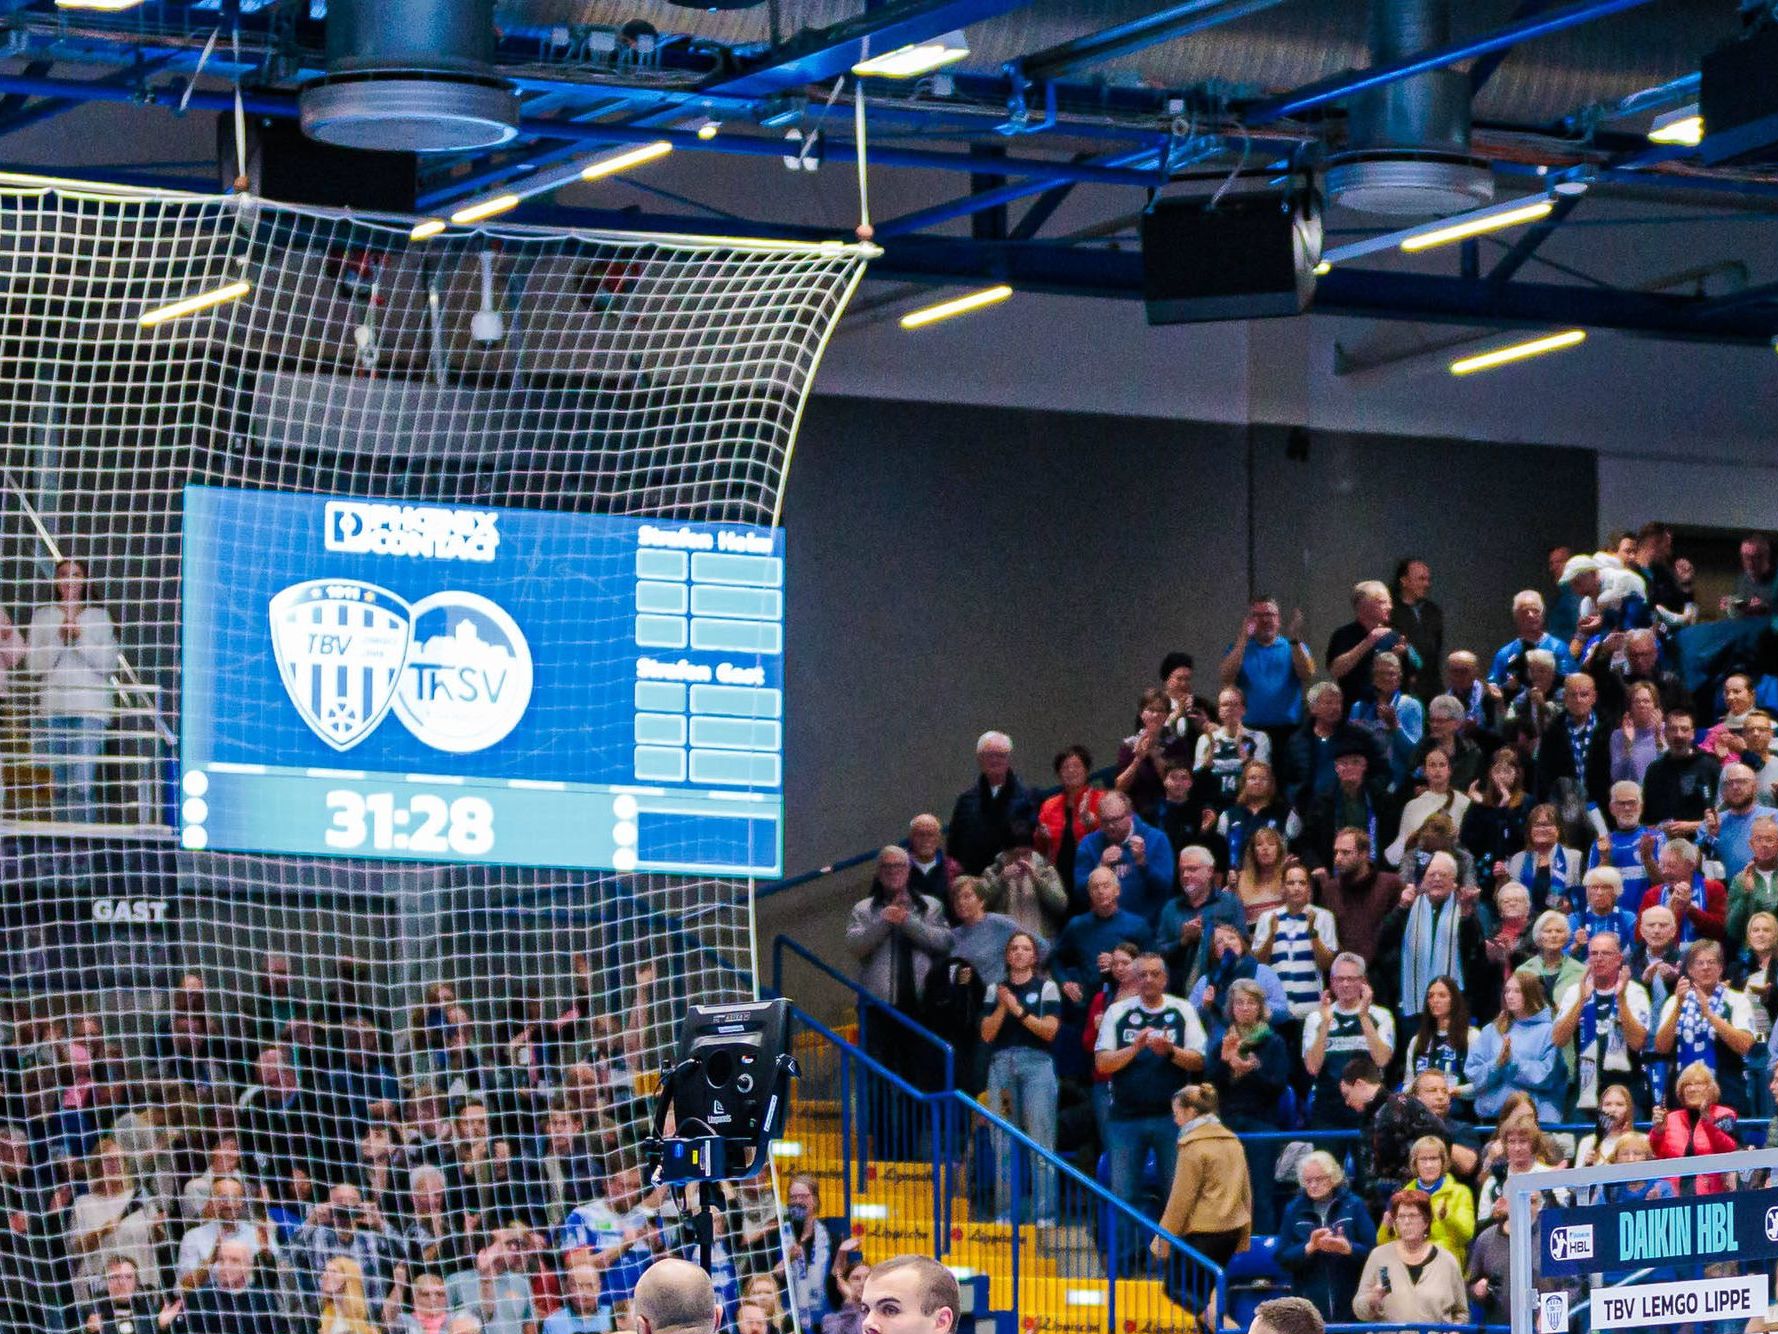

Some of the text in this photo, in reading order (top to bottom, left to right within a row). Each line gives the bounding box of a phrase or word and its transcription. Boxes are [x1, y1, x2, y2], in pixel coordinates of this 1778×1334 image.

[308, 633, 352, 656] TBV
[325, 789, 495, 855] 31:28
[92, 901, 169, 923] GAST
[1619, 1201, 1739, 1262] DAIKIN HBL
[1604, 1287, 1751, 1321] TBV LEMGO LIPPE
